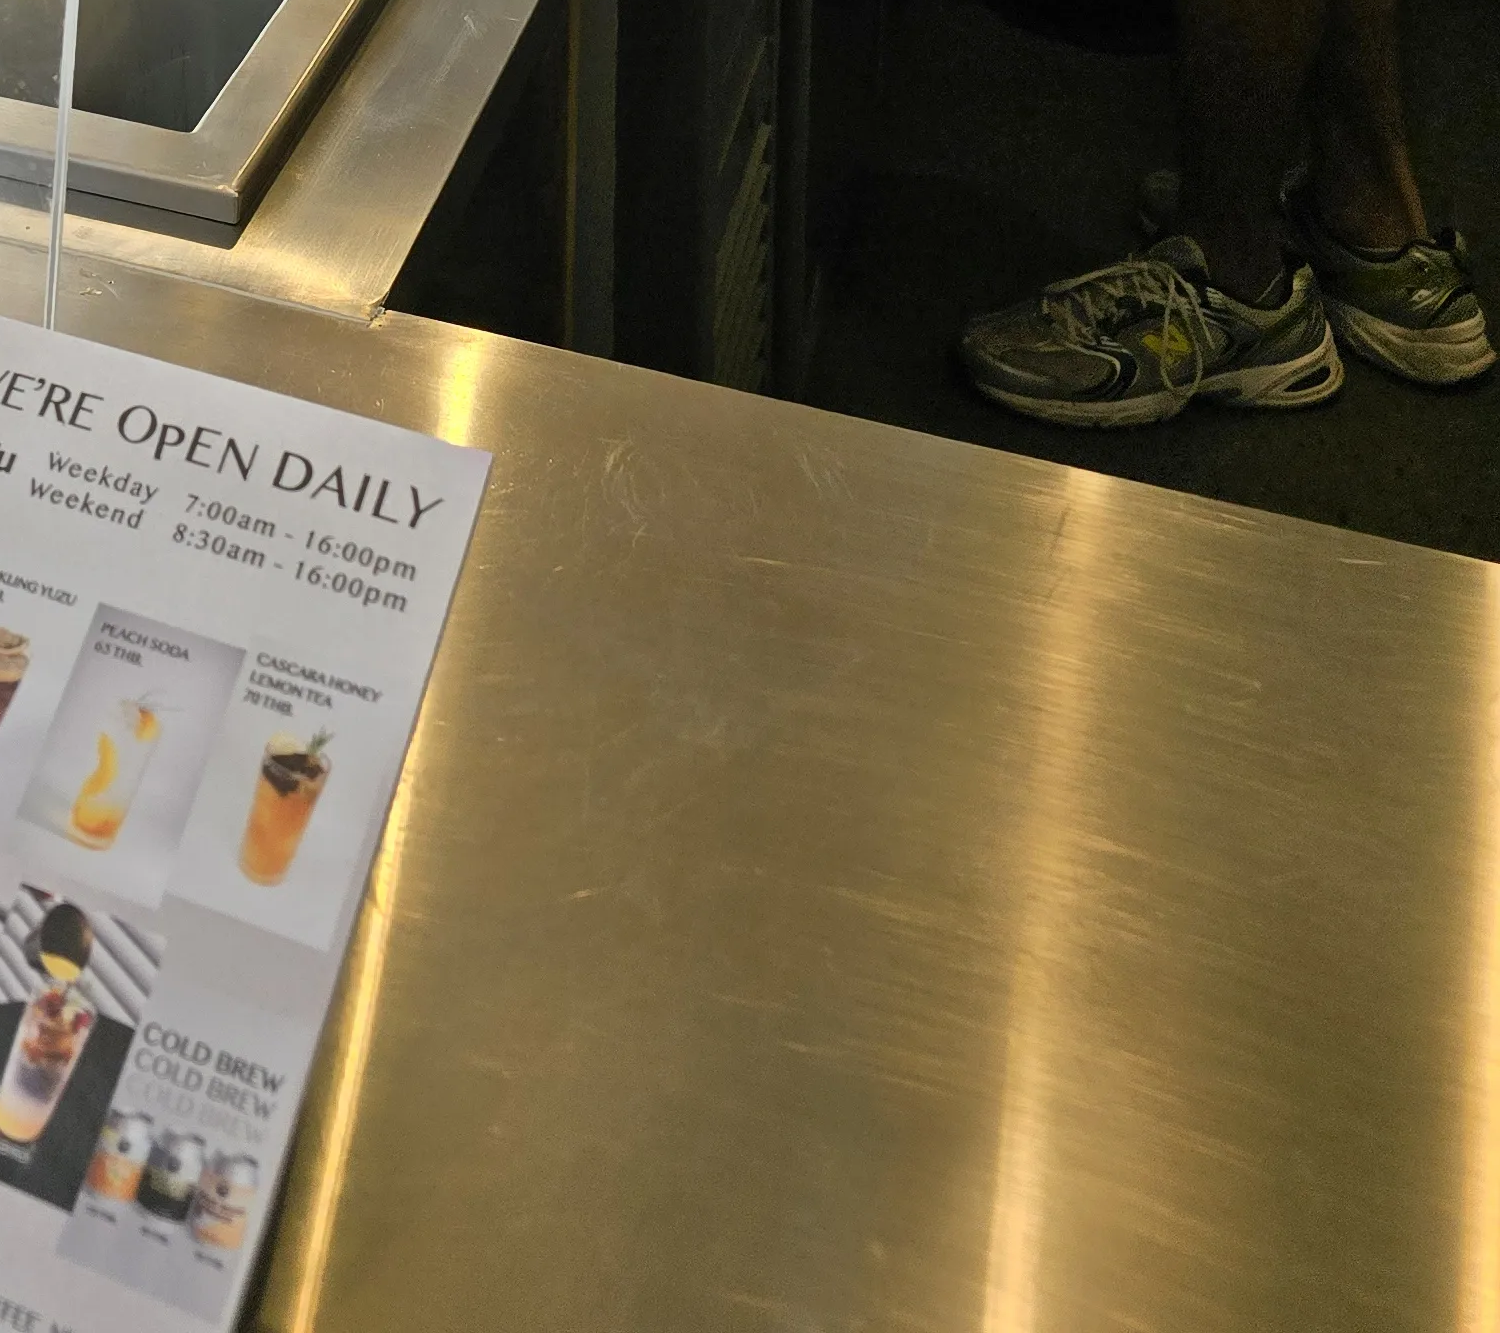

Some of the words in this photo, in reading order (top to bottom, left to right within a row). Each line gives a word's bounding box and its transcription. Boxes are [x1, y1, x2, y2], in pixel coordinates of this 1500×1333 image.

[116, 404, 260, 483] OPEN
[271, 450, 445, 531] DAILY
[29, 478, 145, 531] Weekend
[172, 523, 266, 569] 8:30am
[294, 561, 409, 614] 16:00pm
[48, 451, 159, 505] Weekday
[184, 493, 276, 539] 7:00am
[304, 530, 418, 583] 16:00pm
[38, 582, 79, 607] YUZU
[100, 621, 150, 650] PEACH
[148, 636, 191, 662] SODA
[255, 652, 334, 690] CASCARA
[332, 673, 384, 704] HONEY
[249, 670, 305, 698] LEMON
[303, 687, 333, 710] TEA
[133, 1047, 204, 1092] COLD
[205, 1076, 277, 1121] BREW
[143, 1020, 212, 1066] COLD
[215, 1049, 286, 1093] BREW
